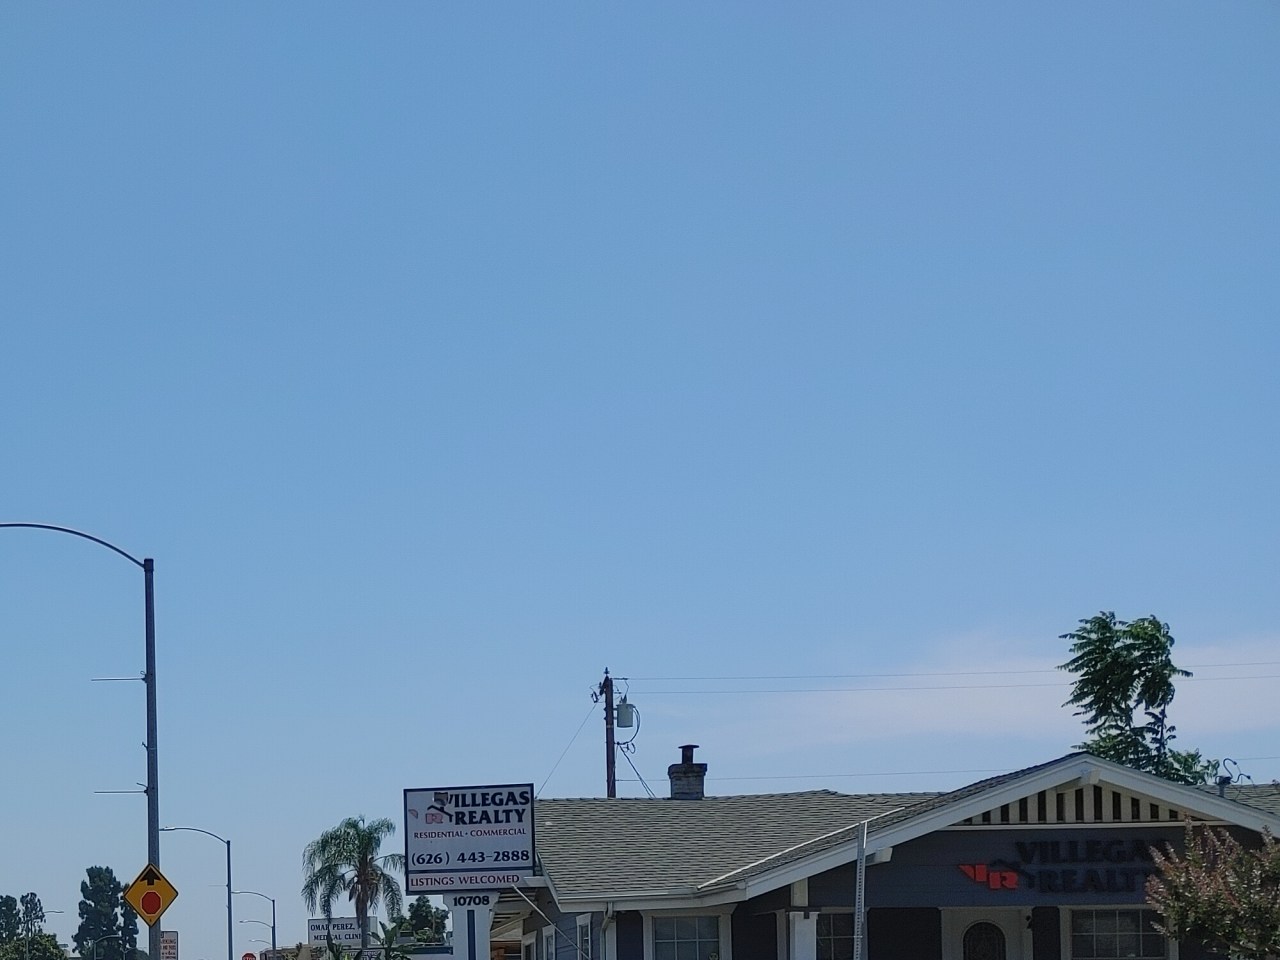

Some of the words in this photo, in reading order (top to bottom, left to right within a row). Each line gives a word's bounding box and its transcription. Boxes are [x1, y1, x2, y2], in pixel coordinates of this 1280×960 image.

[454, 808, 526, 825] REALTY
[414, 830, 464, 839] RESIDENTIAL
[470, 828, 526, 837] COMMERCIAL
[411, 851, 450, 866] (626)
[456, 849, 530, 863] 443-2888
[410, 876, 455, 887] LISTINGS
[458, 874, 520, 885] WELCOMED
[453, 895, 490, 906] 10708
